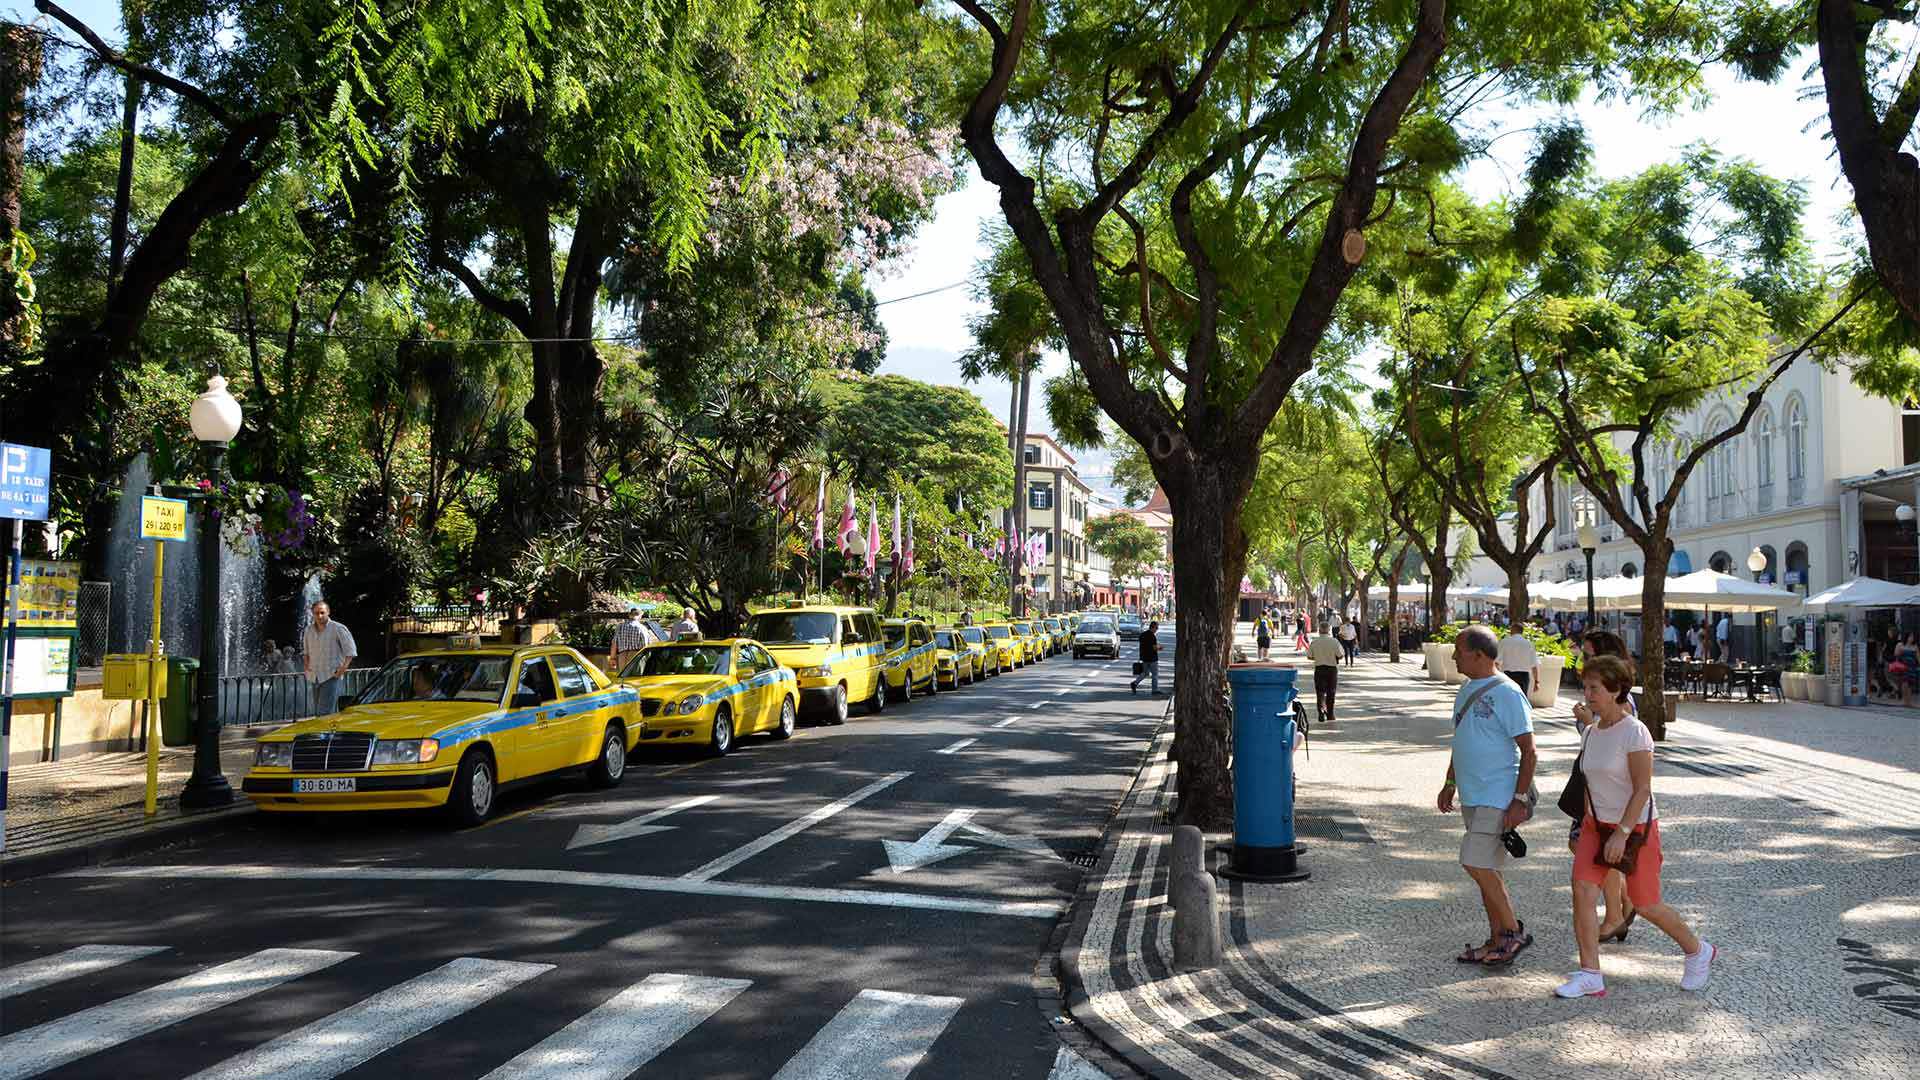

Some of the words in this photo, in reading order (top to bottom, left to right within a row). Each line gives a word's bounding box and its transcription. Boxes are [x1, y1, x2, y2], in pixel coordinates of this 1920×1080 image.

[2, 446, 27, 484] P
[156, 506, 175, 518] TAXI
[145, 520, 158, 529] 291
[160, 522, 171, 531] 220
